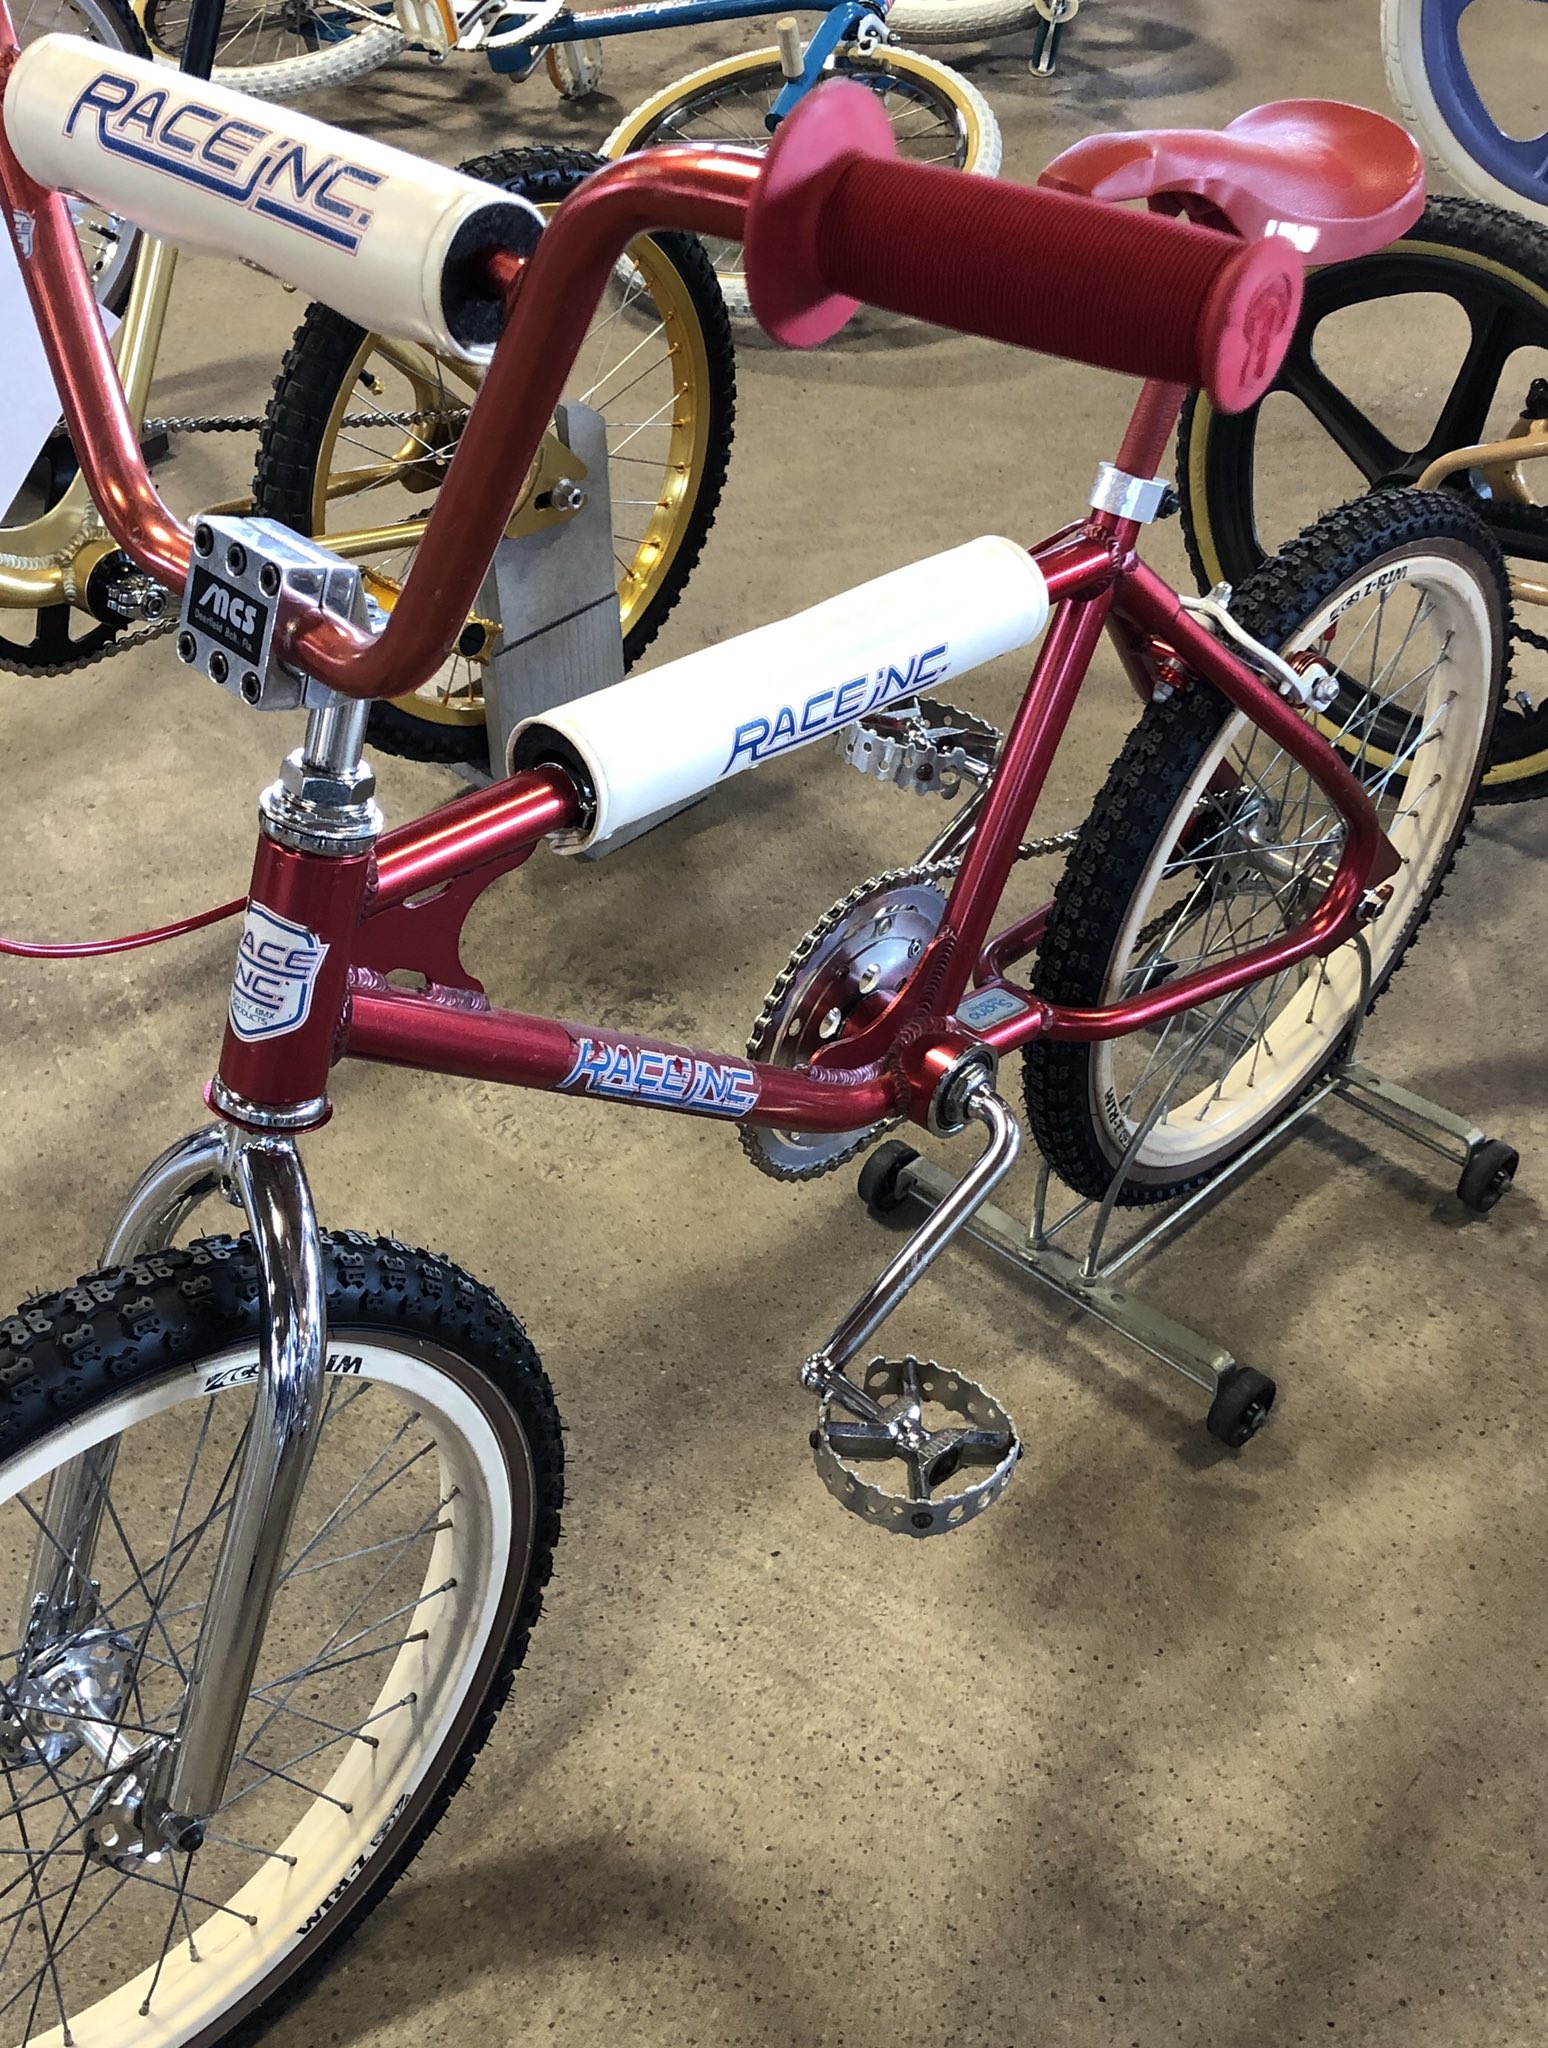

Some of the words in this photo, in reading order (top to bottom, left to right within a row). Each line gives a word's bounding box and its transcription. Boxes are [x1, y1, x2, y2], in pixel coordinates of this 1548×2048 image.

[1364, 565, 1408, 597] Z-RIM
[198, 582, 258, 636] MCS
[242, 930, 318, 971] ACE
[296, 1853, 371, 1935] Z-RIM
